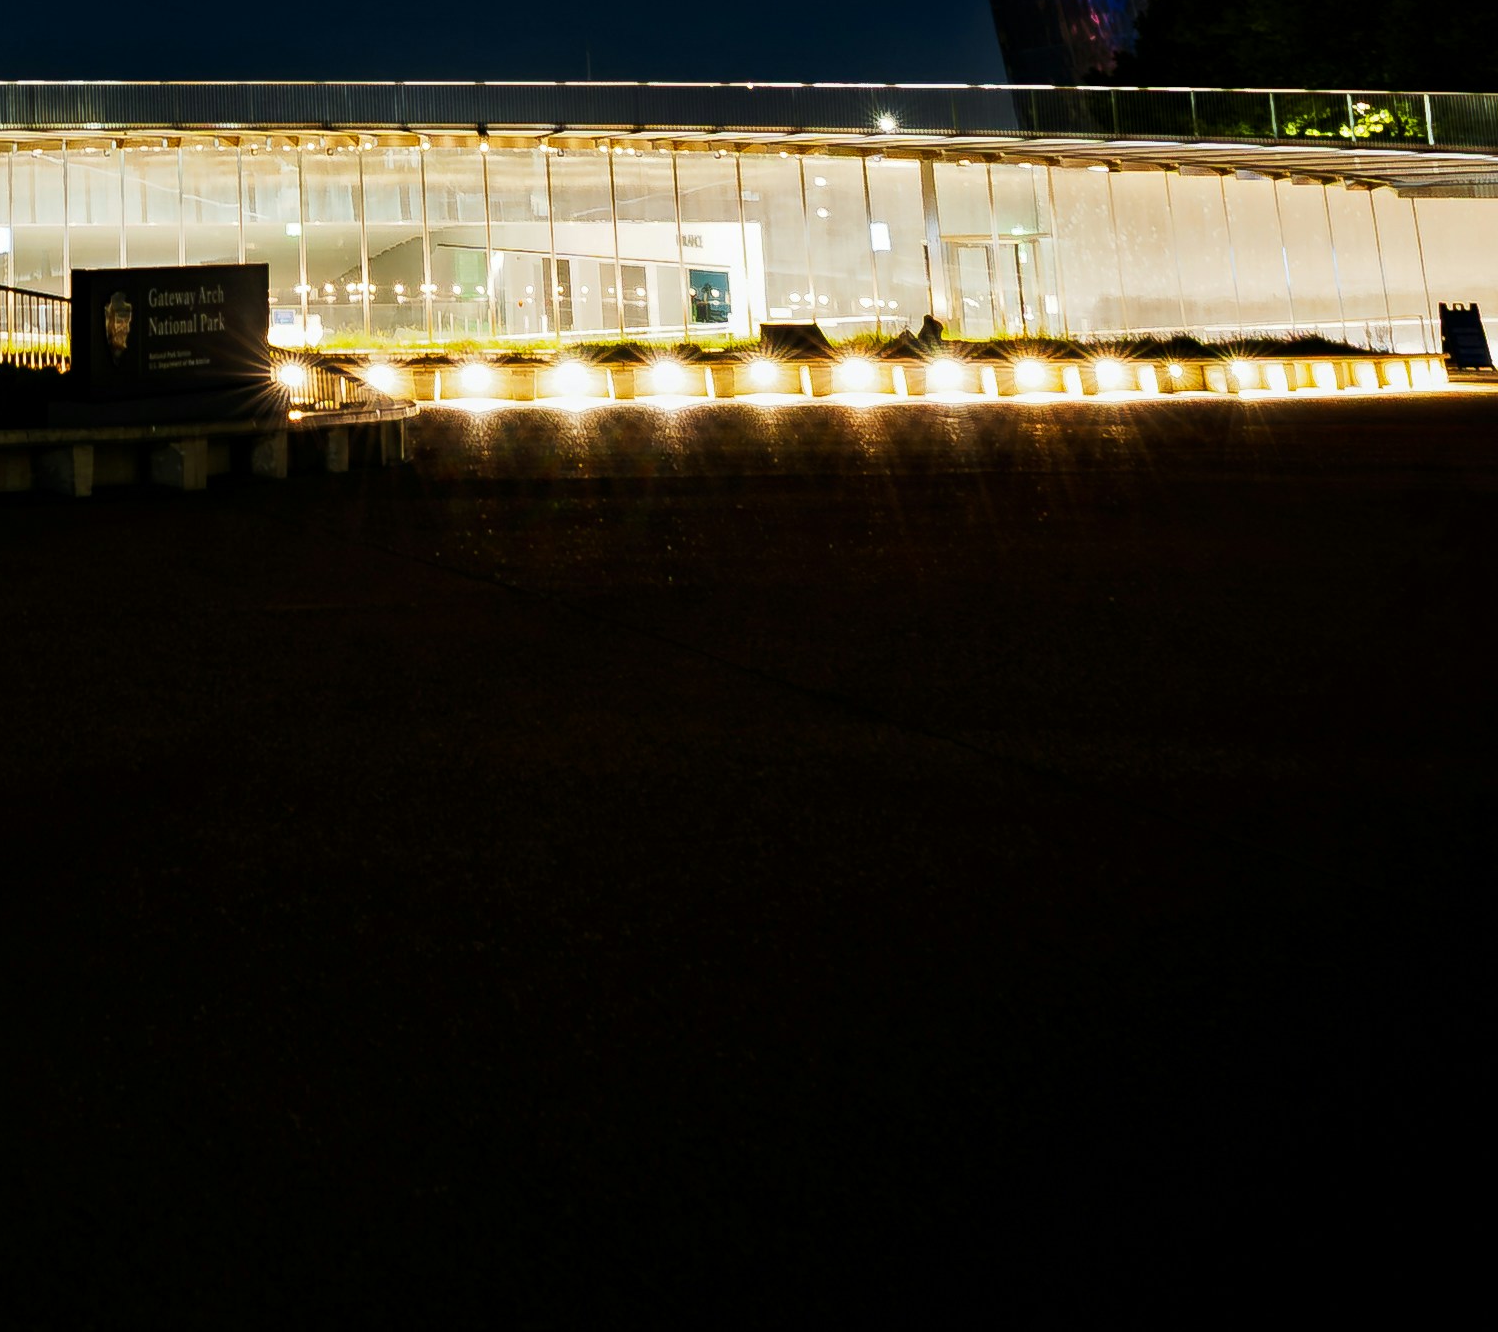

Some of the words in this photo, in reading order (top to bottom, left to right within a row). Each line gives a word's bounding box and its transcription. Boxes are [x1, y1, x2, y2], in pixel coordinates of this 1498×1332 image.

[148, 287, 195, 311] Gateway
[198, 284, 224, 304] Arch
[148, 312, 197, 337] National
[200, 311, 225, 333] Park
